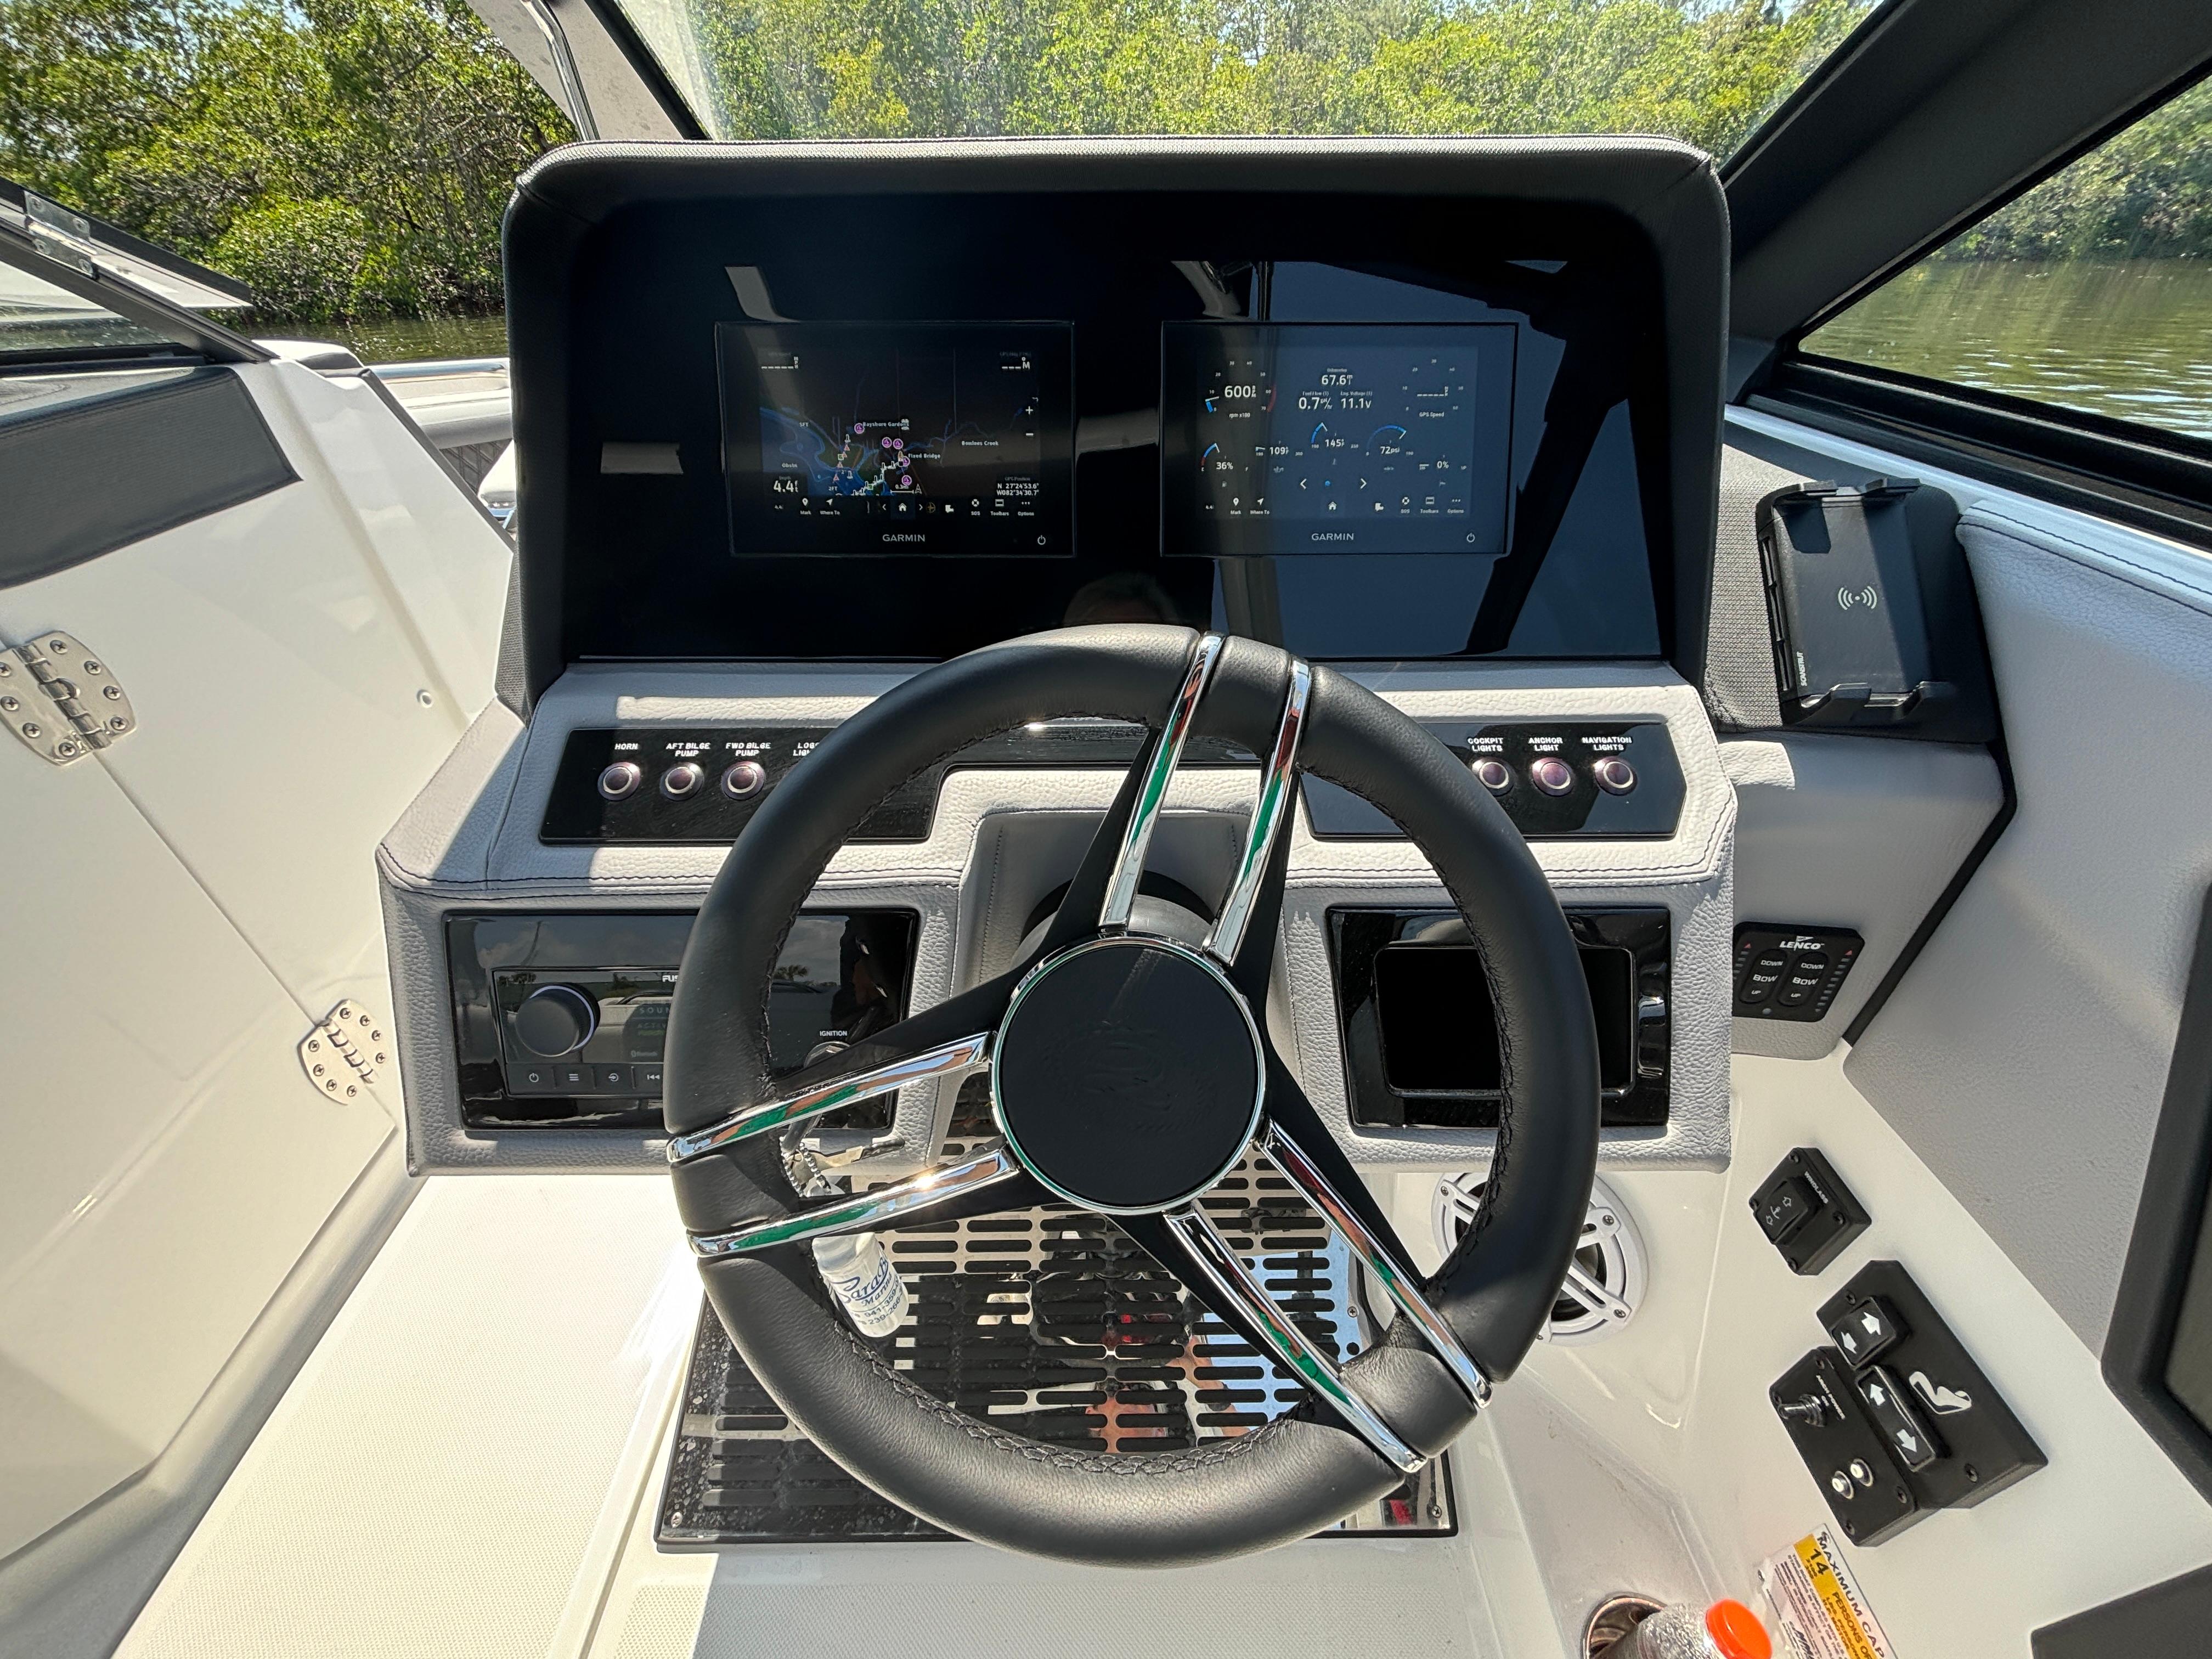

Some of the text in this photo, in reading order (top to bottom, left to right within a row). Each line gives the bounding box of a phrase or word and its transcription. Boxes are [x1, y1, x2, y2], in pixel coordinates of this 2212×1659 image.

[1224, 386, 1251, 398] 600
[882, 534, 926, 542] GARMIN
[1780, 940, 1821, 951] LENCO
[1792, 977, 1819, 985] BOW
[1804, 1170, 1829, 1204] WINDLASS
[1816, 1375, 1846, 1420] ARCH POWER
[1810, 1548, 1829, 1575] 14
[1832, 1592, 1862, 1643] PERSONS
[1817, 1537, 1885, 1658] MAXIMUM CAP
